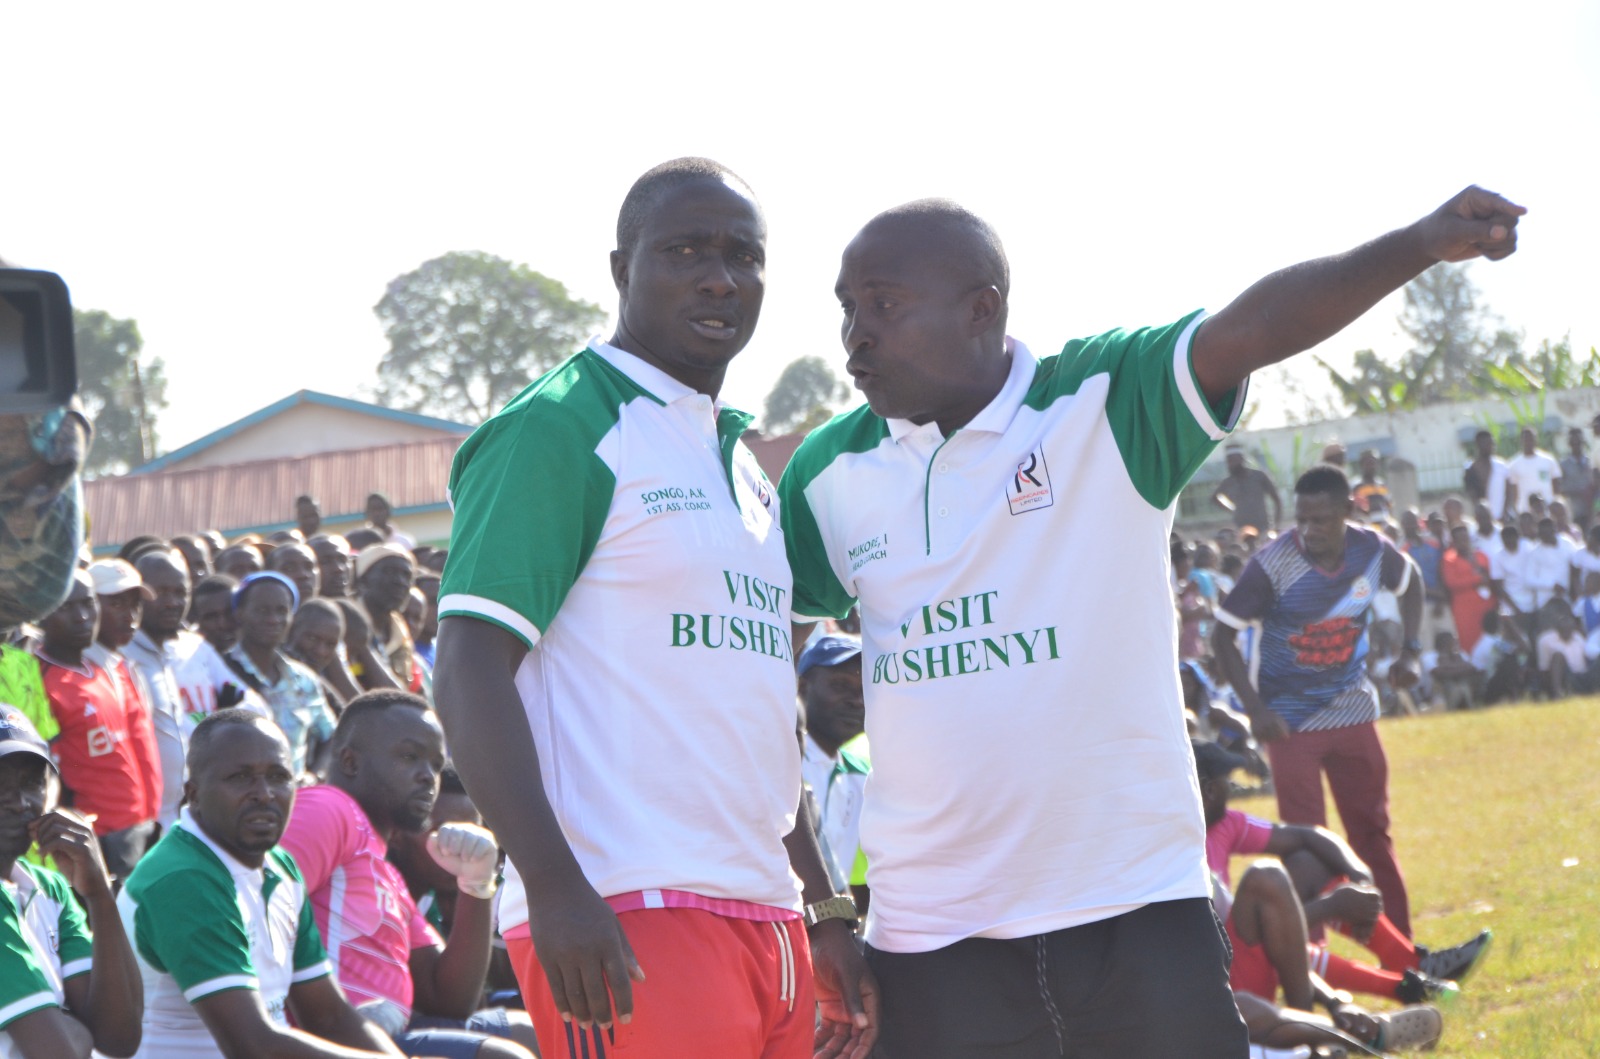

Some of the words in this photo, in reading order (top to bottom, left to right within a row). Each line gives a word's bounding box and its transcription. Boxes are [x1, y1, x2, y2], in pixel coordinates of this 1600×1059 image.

[641, 487, 688, 504] SONGO,
[666, 502, 684, 512] ASS.
[684, 502, 712, 510] COACH
[723, 570, 786, 618] VISIT
[872, 626, 1061, 684] BUSHENYI
